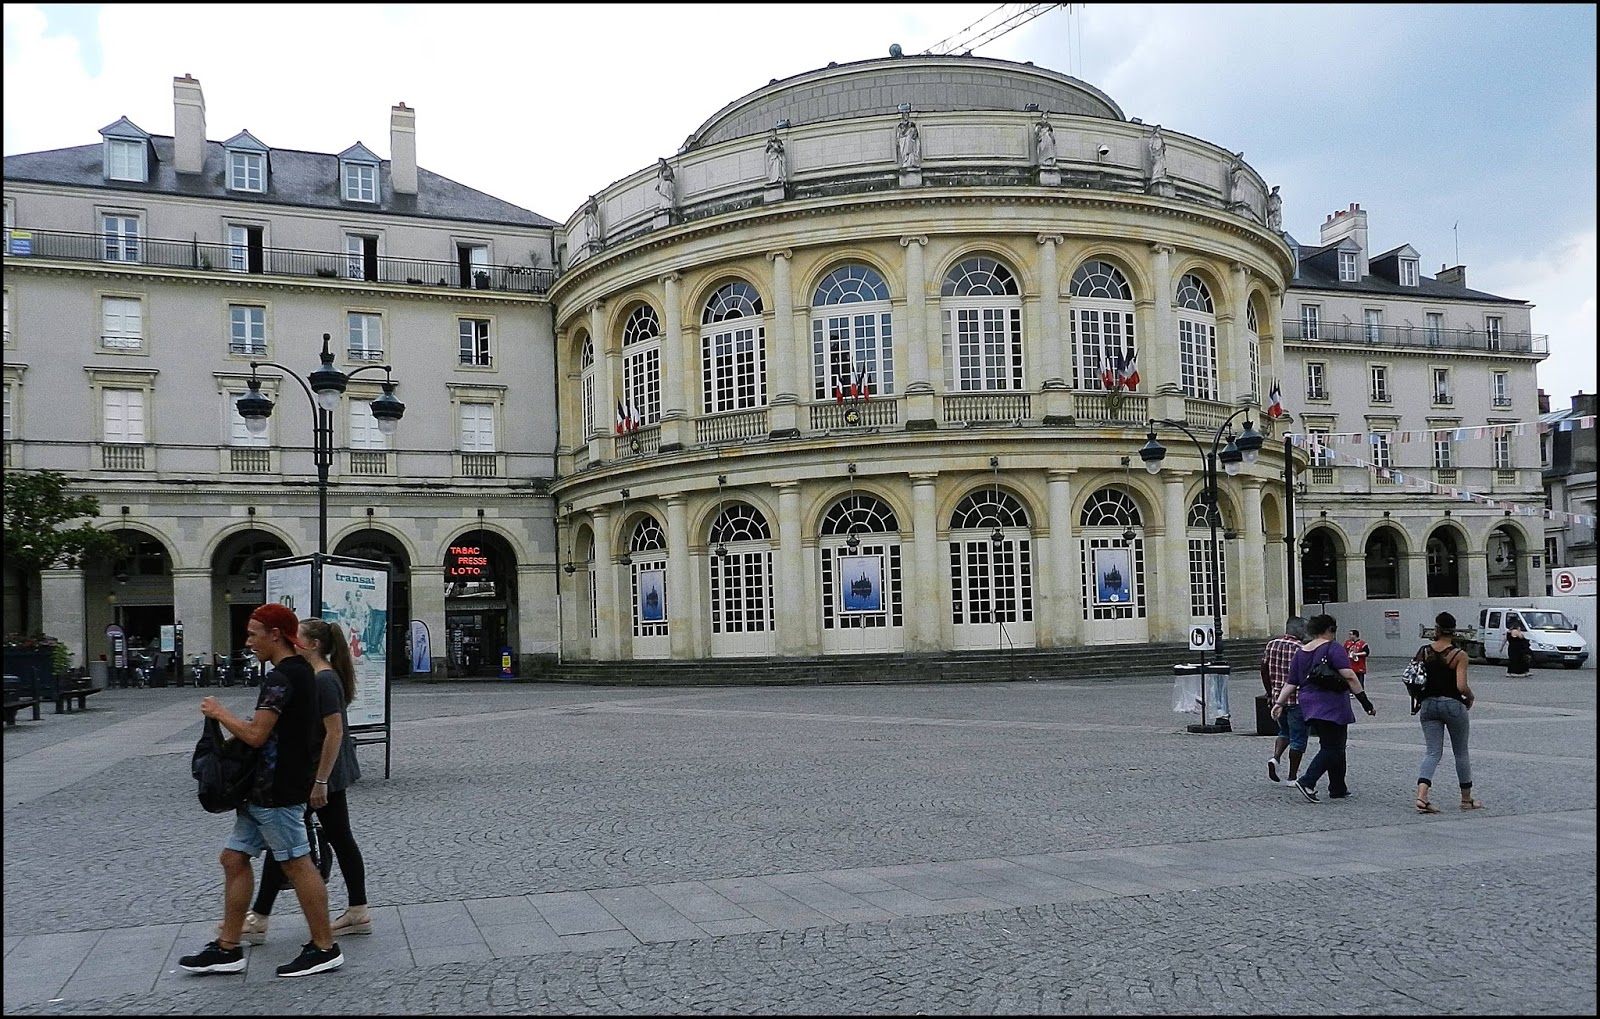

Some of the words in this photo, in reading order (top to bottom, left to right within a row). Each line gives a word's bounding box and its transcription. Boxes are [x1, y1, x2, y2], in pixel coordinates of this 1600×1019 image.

[450, 546, 480, 555] TABAC
[458, 557, 487, 565] PRESSE
[451, 567, 481, 575] LOTO
[335, 572, 376, 585] transat
